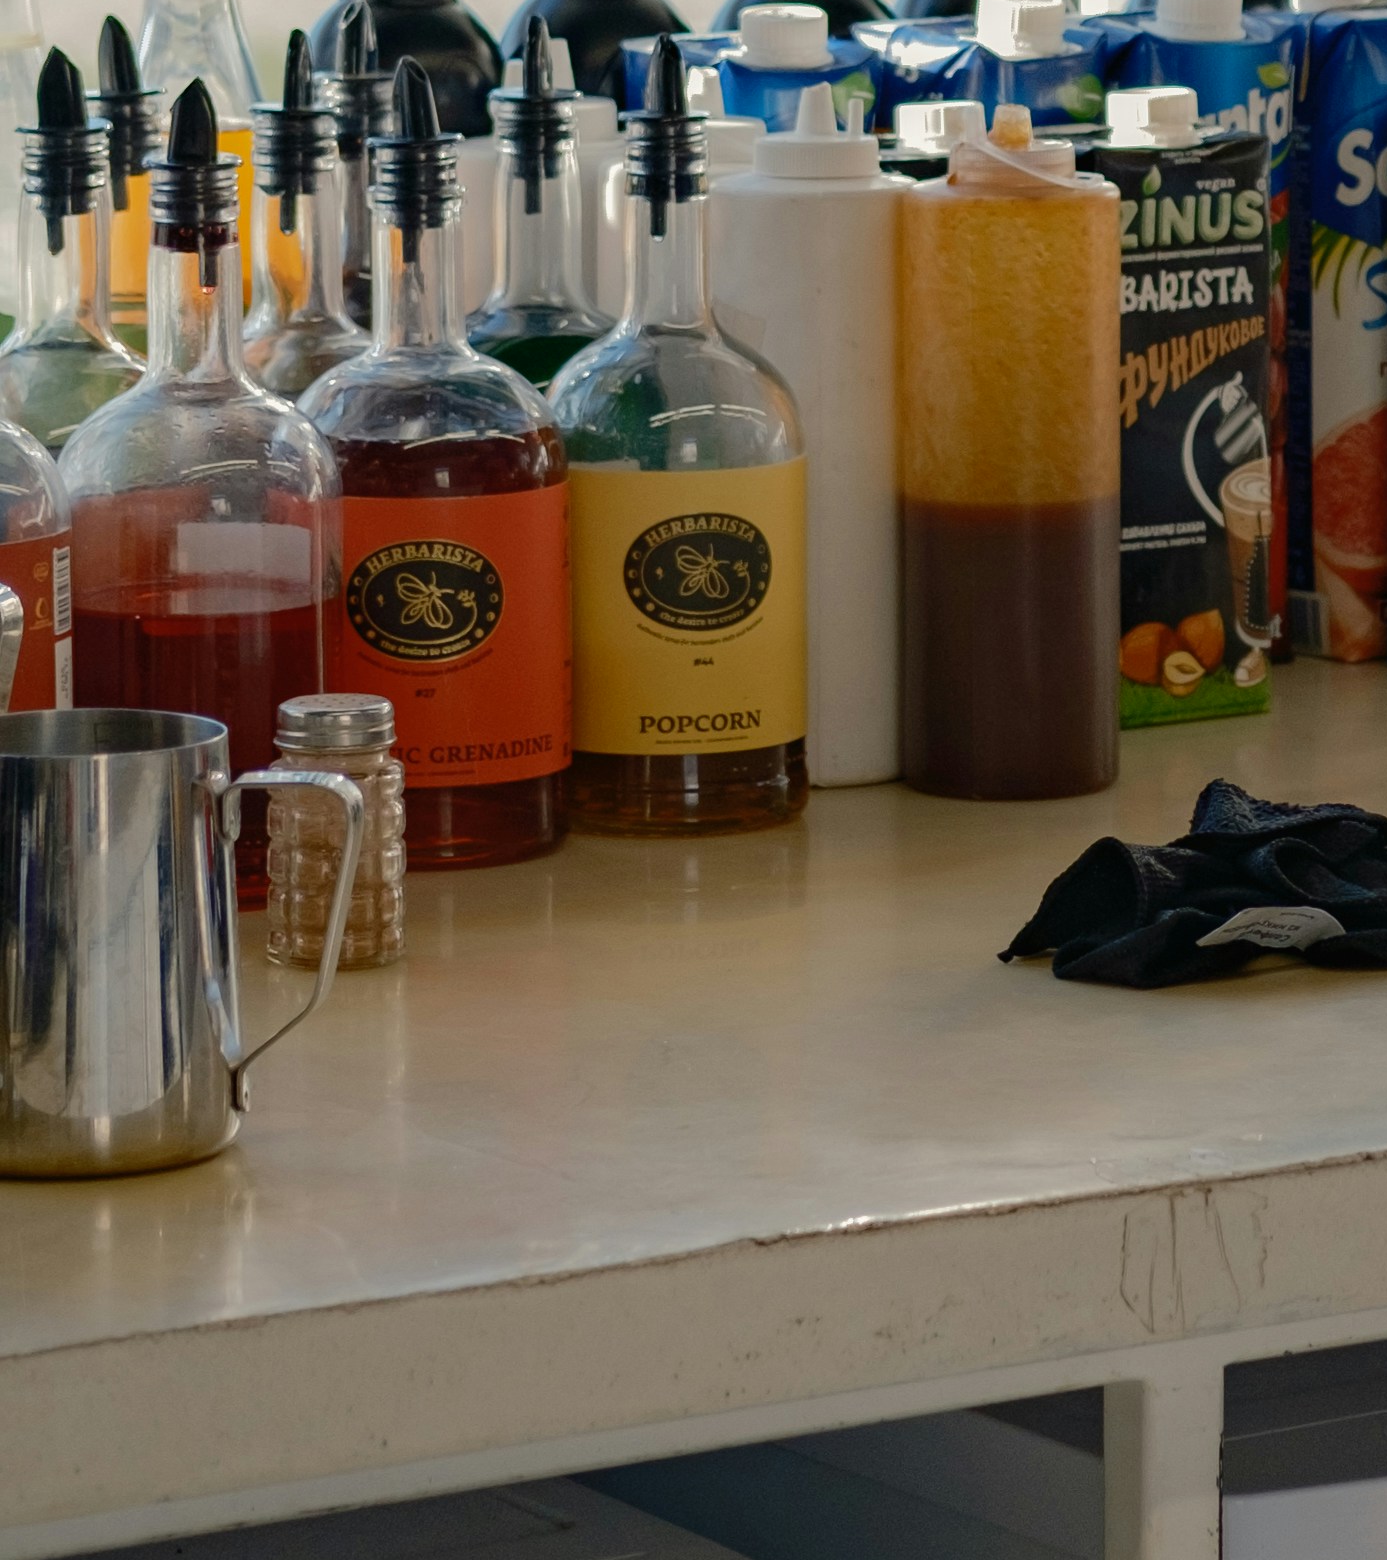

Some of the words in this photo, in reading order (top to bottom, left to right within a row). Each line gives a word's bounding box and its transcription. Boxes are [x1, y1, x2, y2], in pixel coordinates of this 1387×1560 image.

[1120, 266, 1254, 315] BARISTA
[644, 516, 756, 548] HERBARISTA
[365, 542, 484, 575] HERBARISTA
[639, 709, 762, 734] POPCORN
[429, 734, 553, 764] GRENADINE
